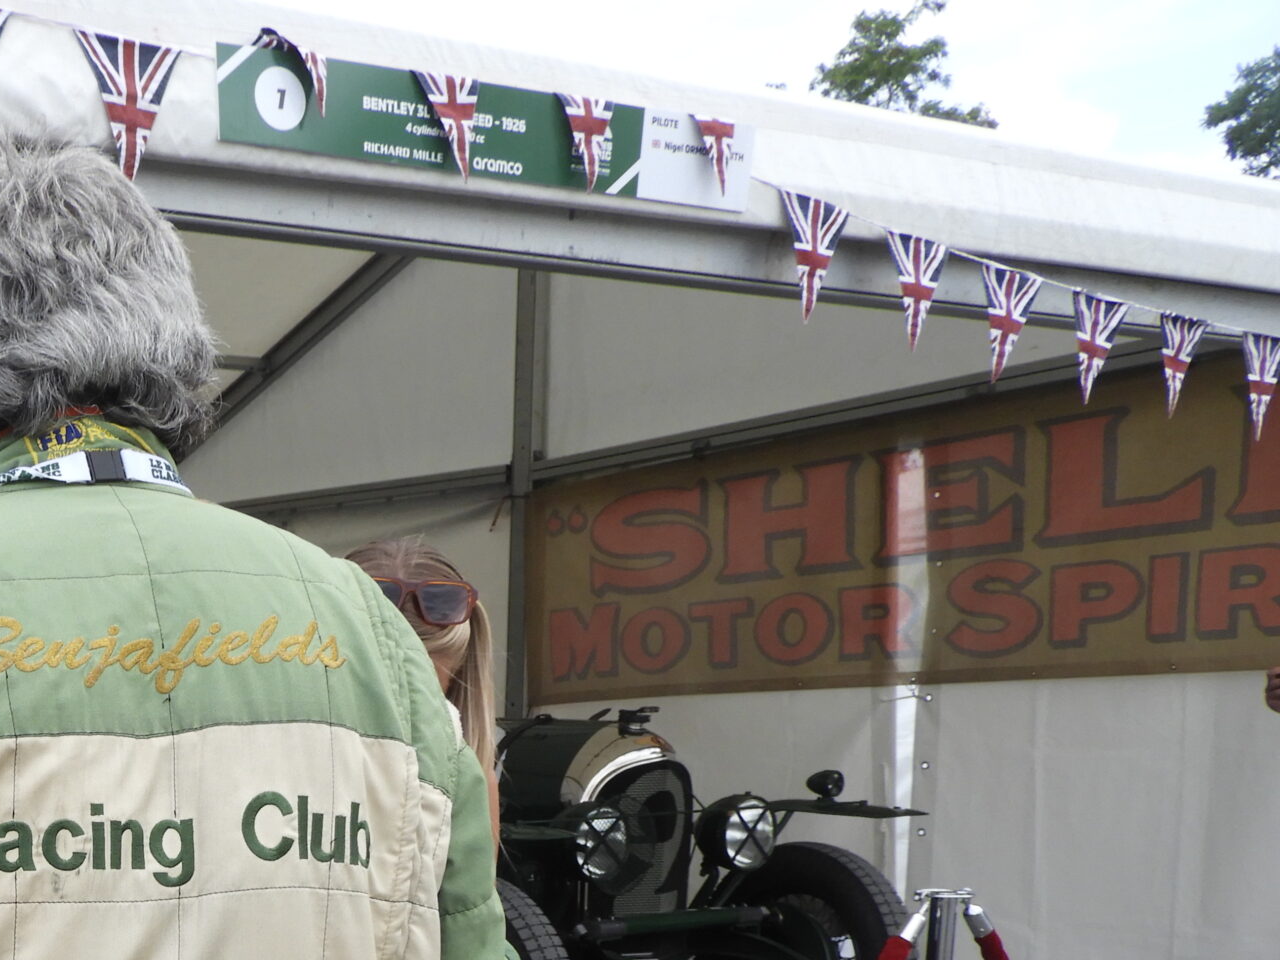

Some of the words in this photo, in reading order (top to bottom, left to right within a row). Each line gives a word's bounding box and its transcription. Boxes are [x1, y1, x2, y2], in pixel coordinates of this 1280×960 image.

[276, 87, 287, 110] 1
[362, 95, 416, 116] BENTLEY
[416, 104, 431, 119] 3L
[501, 116, 527, 133] 1926
[405, 122, 413, 133] 4
[651, 116, 680, 129] PILOTE
[363, 141, 411, 159] RICHARD
[412, 148, 444, 163] MILLE
[472, 156, 523, 176] aramco
[664, 141, 684, 152] Nigel
[547, 580, 921, 684] MOTOR
[947, 540, 1280, 658] SPIR
[240, 790, 372, 870] Club
